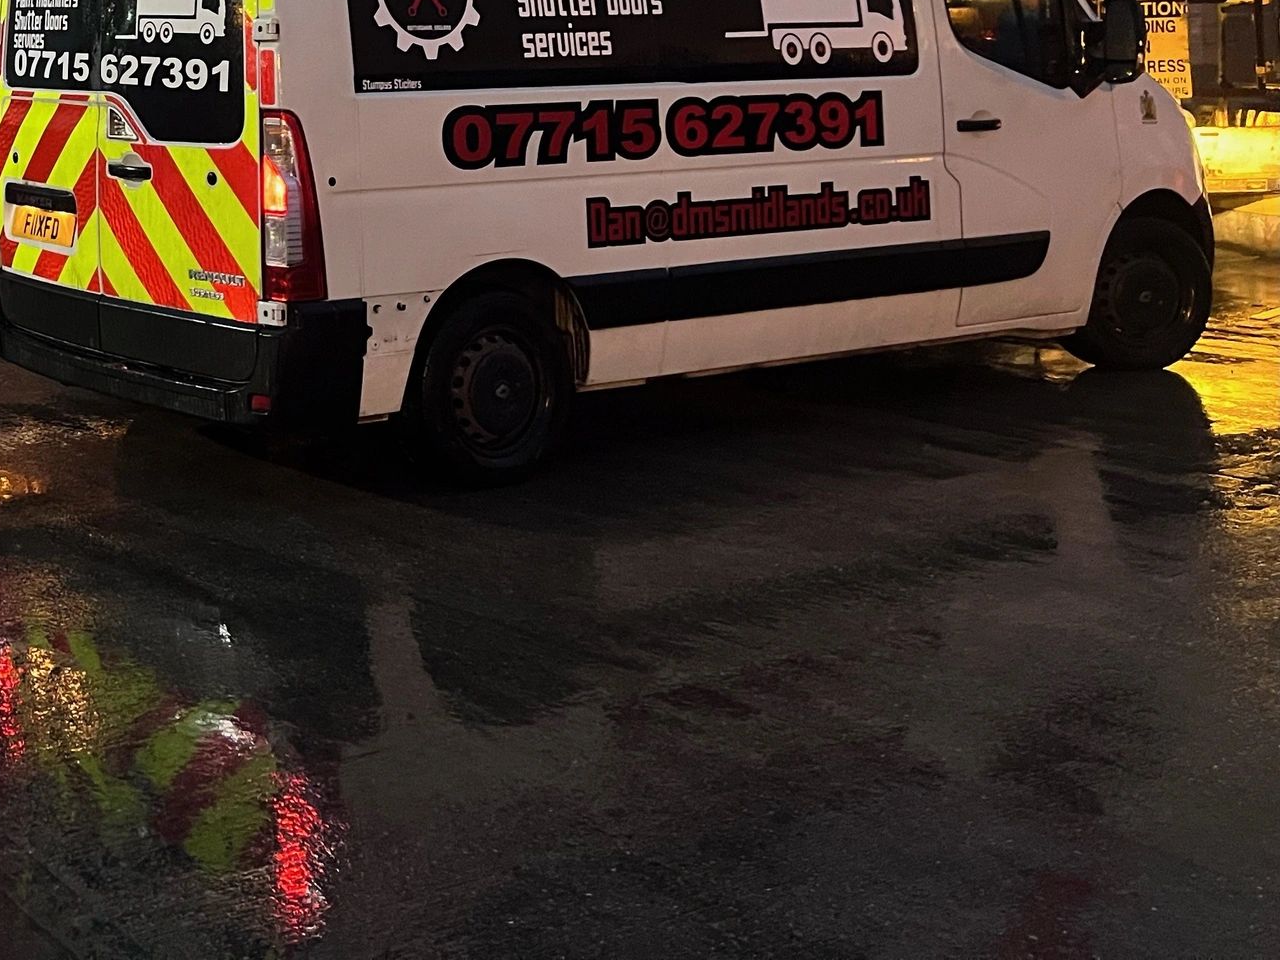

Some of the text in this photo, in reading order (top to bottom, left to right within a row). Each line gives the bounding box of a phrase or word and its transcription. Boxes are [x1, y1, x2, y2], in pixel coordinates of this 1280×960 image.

[1141, 0, 1185, 17] TION
[14, 10, 68, 30] Shutter Doors
[13, 32, 45, 49] services
[522, 22, 613, 58] services
[14, 49, 230, 92] 07715 627391
[1147, 59, 1186, 73] RESS
[449, 95, 880, 166] 07715 627391
[189, 269, 246, 288] RENAULT
